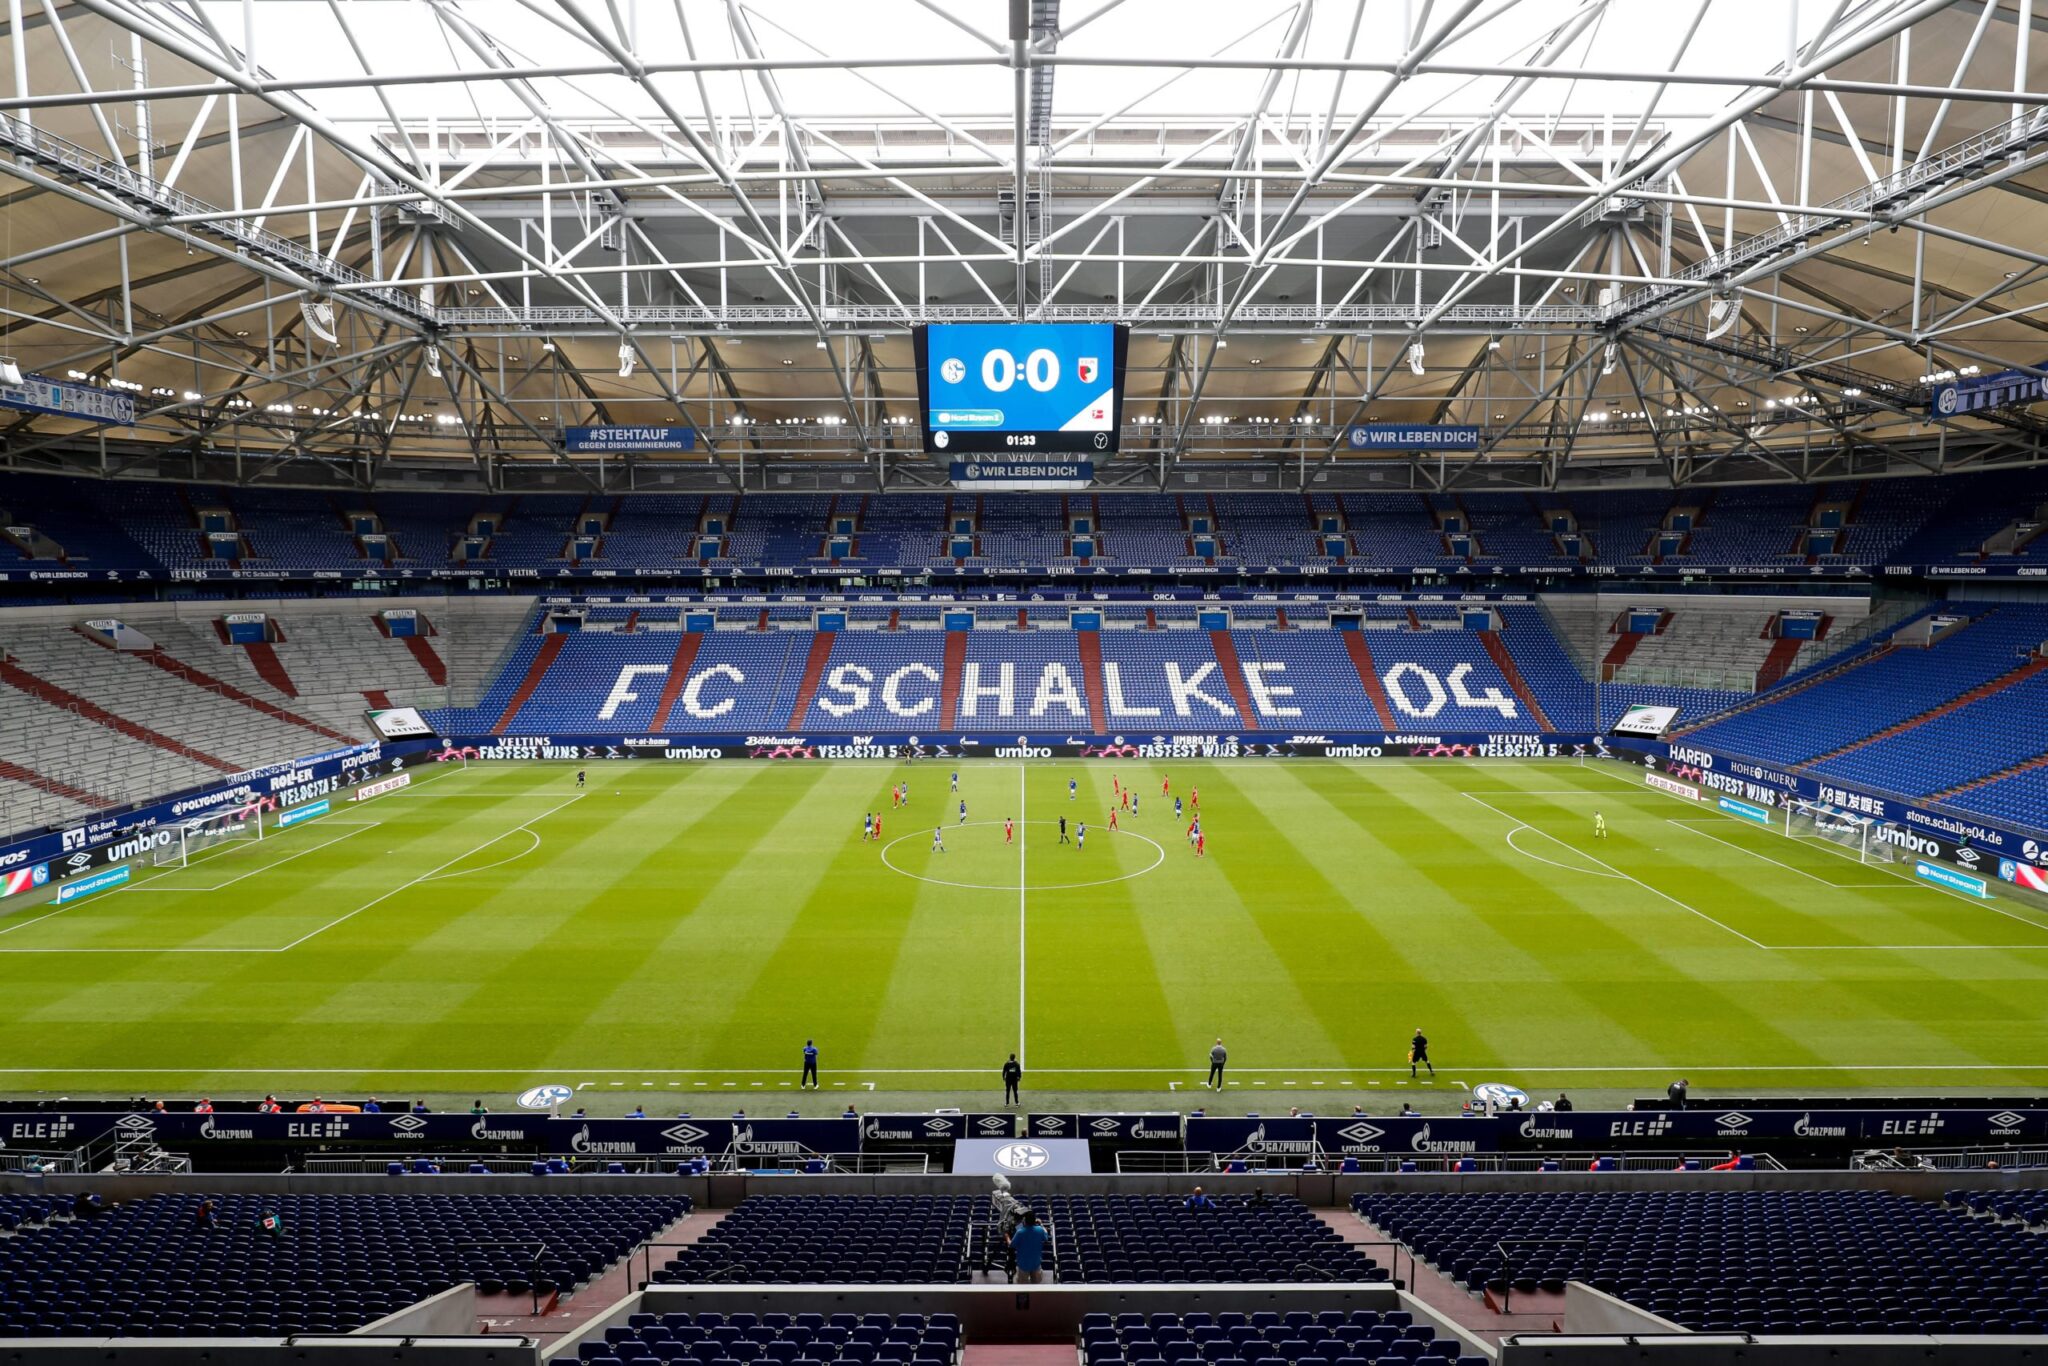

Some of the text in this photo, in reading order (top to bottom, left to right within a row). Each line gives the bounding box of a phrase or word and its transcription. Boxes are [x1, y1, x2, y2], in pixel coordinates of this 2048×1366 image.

[982, 348, 1060, 392] 0:0
[590, 429, 669, 440] #STEHTAUF
[1370, 432, 1477, 442] WIR LEBEN DICH
[608, 441, 682, 449] DISKRIMINIERUNG
[1006, 435, 1036, 446] 01:33
[982, 466, 1077, 476] WIR LEBEN DICH
[170, 570, 208, 578] VELTINS
[1586, 566, 1615, 574] VELTINS
[1885, 566, 1912, 574] VELTINS
[598, 662, 1518, 720] FC SCHALKE 04
[1620, 722, 1662, 732] VELTINS
[498, 737, 550, 746] VELTINS
[745, 736, 806, 746] Böklunder
[853, 736, 874, 744] R+V
[1173, 736, 1218, 744] UMBRO.DE
[1292, 736, 1327, 744] DHL
[1395, 735, 1440, 744] Stölting
[1488, 734, 1540, 744] VELTINS
[480, 746, 538, 759] FASTEST
[665, 747, 722, 760] umbro
[995, 746, 1052, 758] umbro
[1138, 744, 1198, 758] FASTEST
[1325, 746, 1382, 758] umbro
[1670, 745, 1712, 769] HARFID
[270, 768, 314, 791] ROLLER
[1731, 762, 1799, 792] HOHE TAUERN
[88, 819, 118, 834] VR-Bank
[147, 817, 156, 828] eG
[1906, 810, 2002, 845] store.schalke04.de
[108, 830, 170, 862] umbro
[1877, 826, 1940, 857] umbro
[70, 865, 90, 875] umbro
[1957, 860, 1977, 870] umbro
[76, 882, 94, 894] Nord
[95, 872, 123, 890] Stream
[1930, 870, 1948, 880] Nord
[1950, 874, 1976, 890] Stream
[12, 1124, 46, 1138] ELE
[288, 1123, 322, 1137] ELE
[980, 1128, 1004, 1136] umbro
[1038, 1128, 1063, 1136] umbro
[1610, 1122, 1644, 1136] ELE
[1717, 1127, 1748, 1136] umbro
[1809, 1126, 1845, 1136] GAZPROM
[1882, 1120, 1916, 1134] ELE
[1990, 1126, 2020, 1135] umbro
[216, 1129, 253, 1139] GAZPROM
[394, 1130, 424, 1139] umbro
[488, 1130, 524, 1139] GAZPROM
[880, 1130, 913, 1139] GAZPROM
[1144, 1130, 1177, 1139] GAZPROM
[1536, 1129, 1573, 1139] GAZPROM
[590, 1142, 636, 1153] GAZPROM
[666, 1144, 704, 1154] umbro
[754, 1142, 800, 1153] GAZPROM
[1266, 1141, 1311, 1153] GAZPROM
[1342, 1143, 1380, 1152] umbro
[1430, 1140, 1475, 1152] GAZPROM
